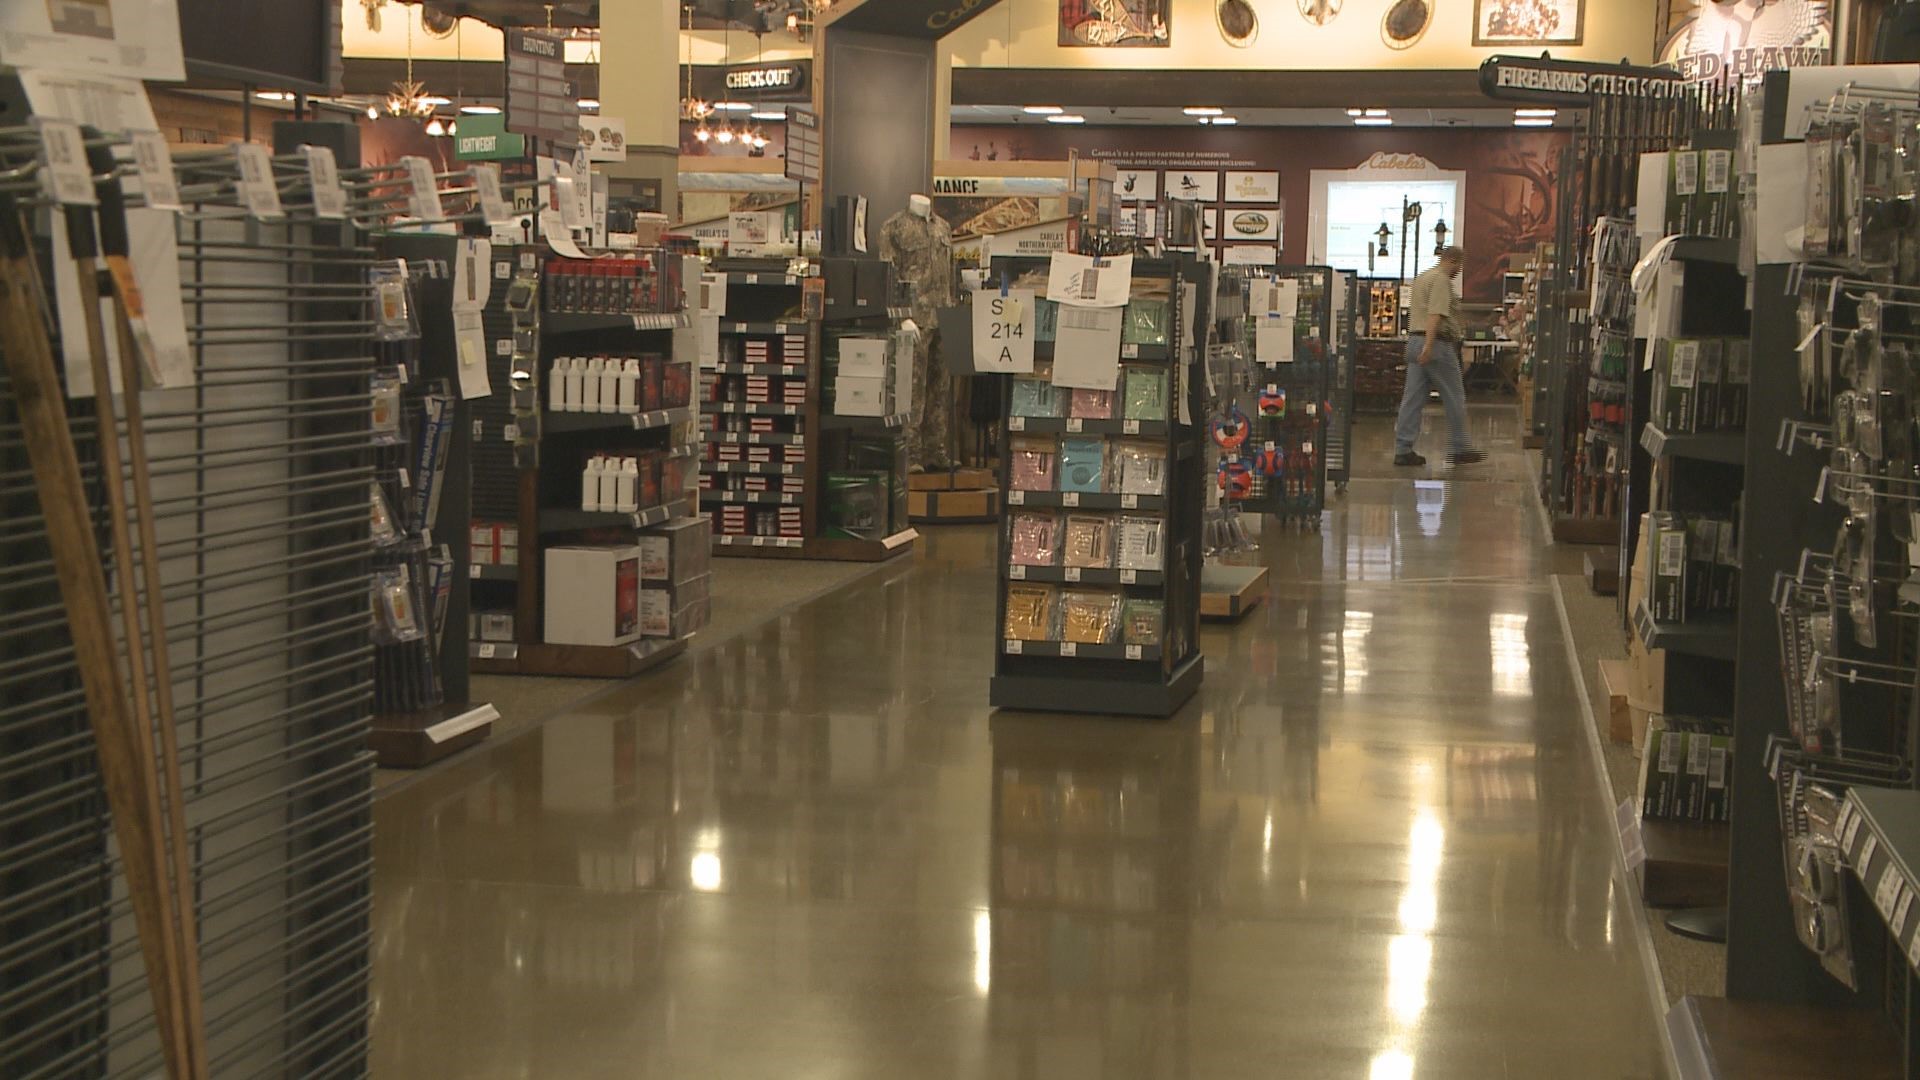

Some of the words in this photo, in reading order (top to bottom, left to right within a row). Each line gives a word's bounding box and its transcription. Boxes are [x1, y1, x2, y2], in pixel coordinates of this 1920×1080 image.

[522, 36, 555, 57] HUNTING
[1677, 51, 1722, 84] ED
[1497, 65, 1588, 95] FIREARMS
[458, 135, 497, 154] LIGHTWEIGHT
[1195, 151, 1230, 159] NUMEROUS
[1369, 151, 1426, 170] Cabela's
[695, 228, 721, 238] CABELA'S
[1040, 231, 1064, 241] CABELA'S
[1018, 240, 1045, 249] NORTHERN
[1046, 240, 1064, 249] FLIGHT
[991, 322, 1024, 339] 214
[999, 346, 1013, 363] A
